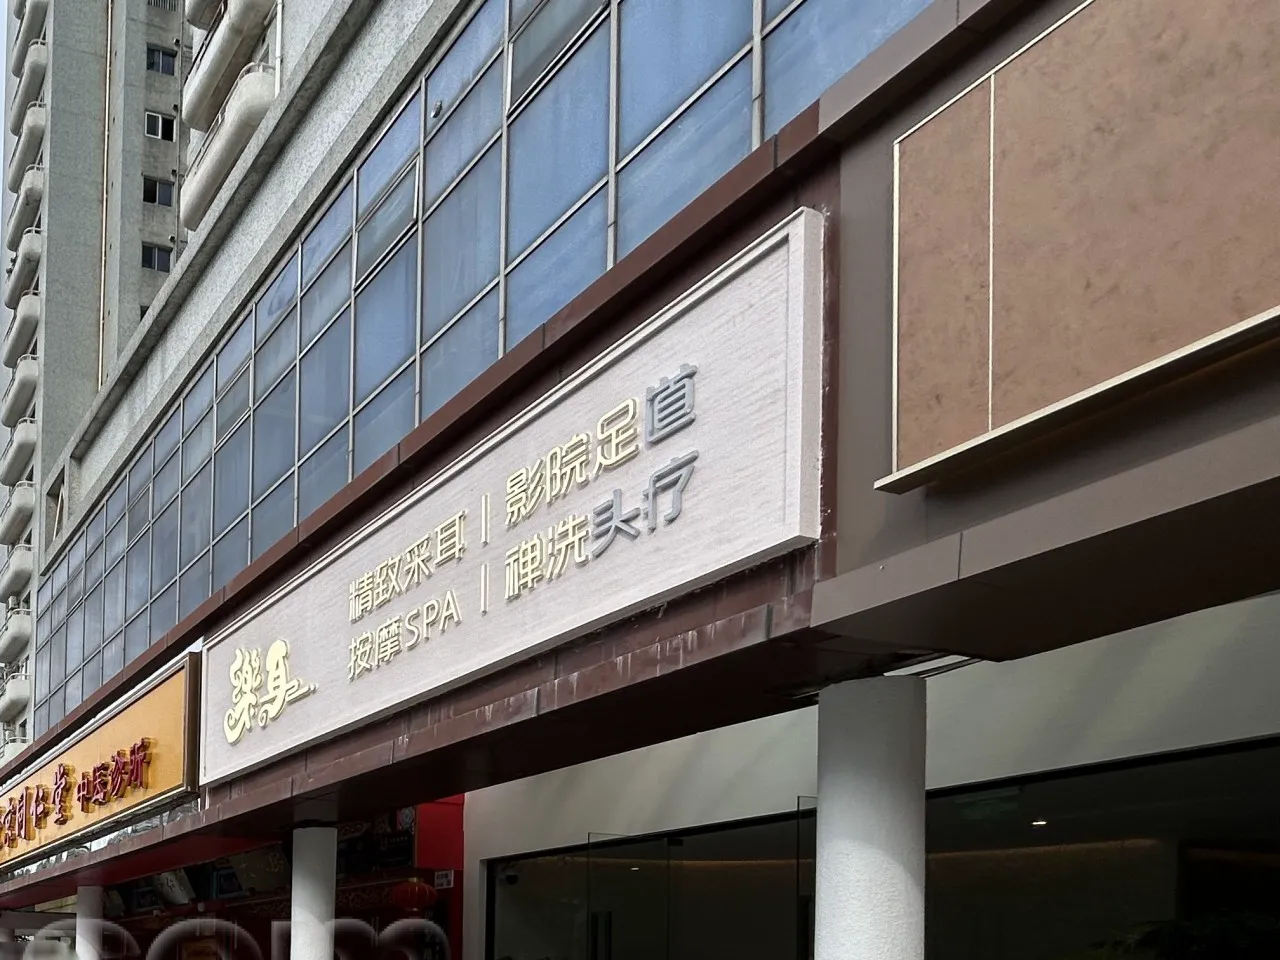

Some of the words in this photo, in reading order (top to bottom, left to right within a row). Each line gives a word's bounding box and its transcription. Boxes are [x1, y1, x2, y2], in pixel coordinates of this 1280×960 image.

[349, 508, 468, 623] 精致采耳
[347, 589, 463, 682] 按摩SPA
